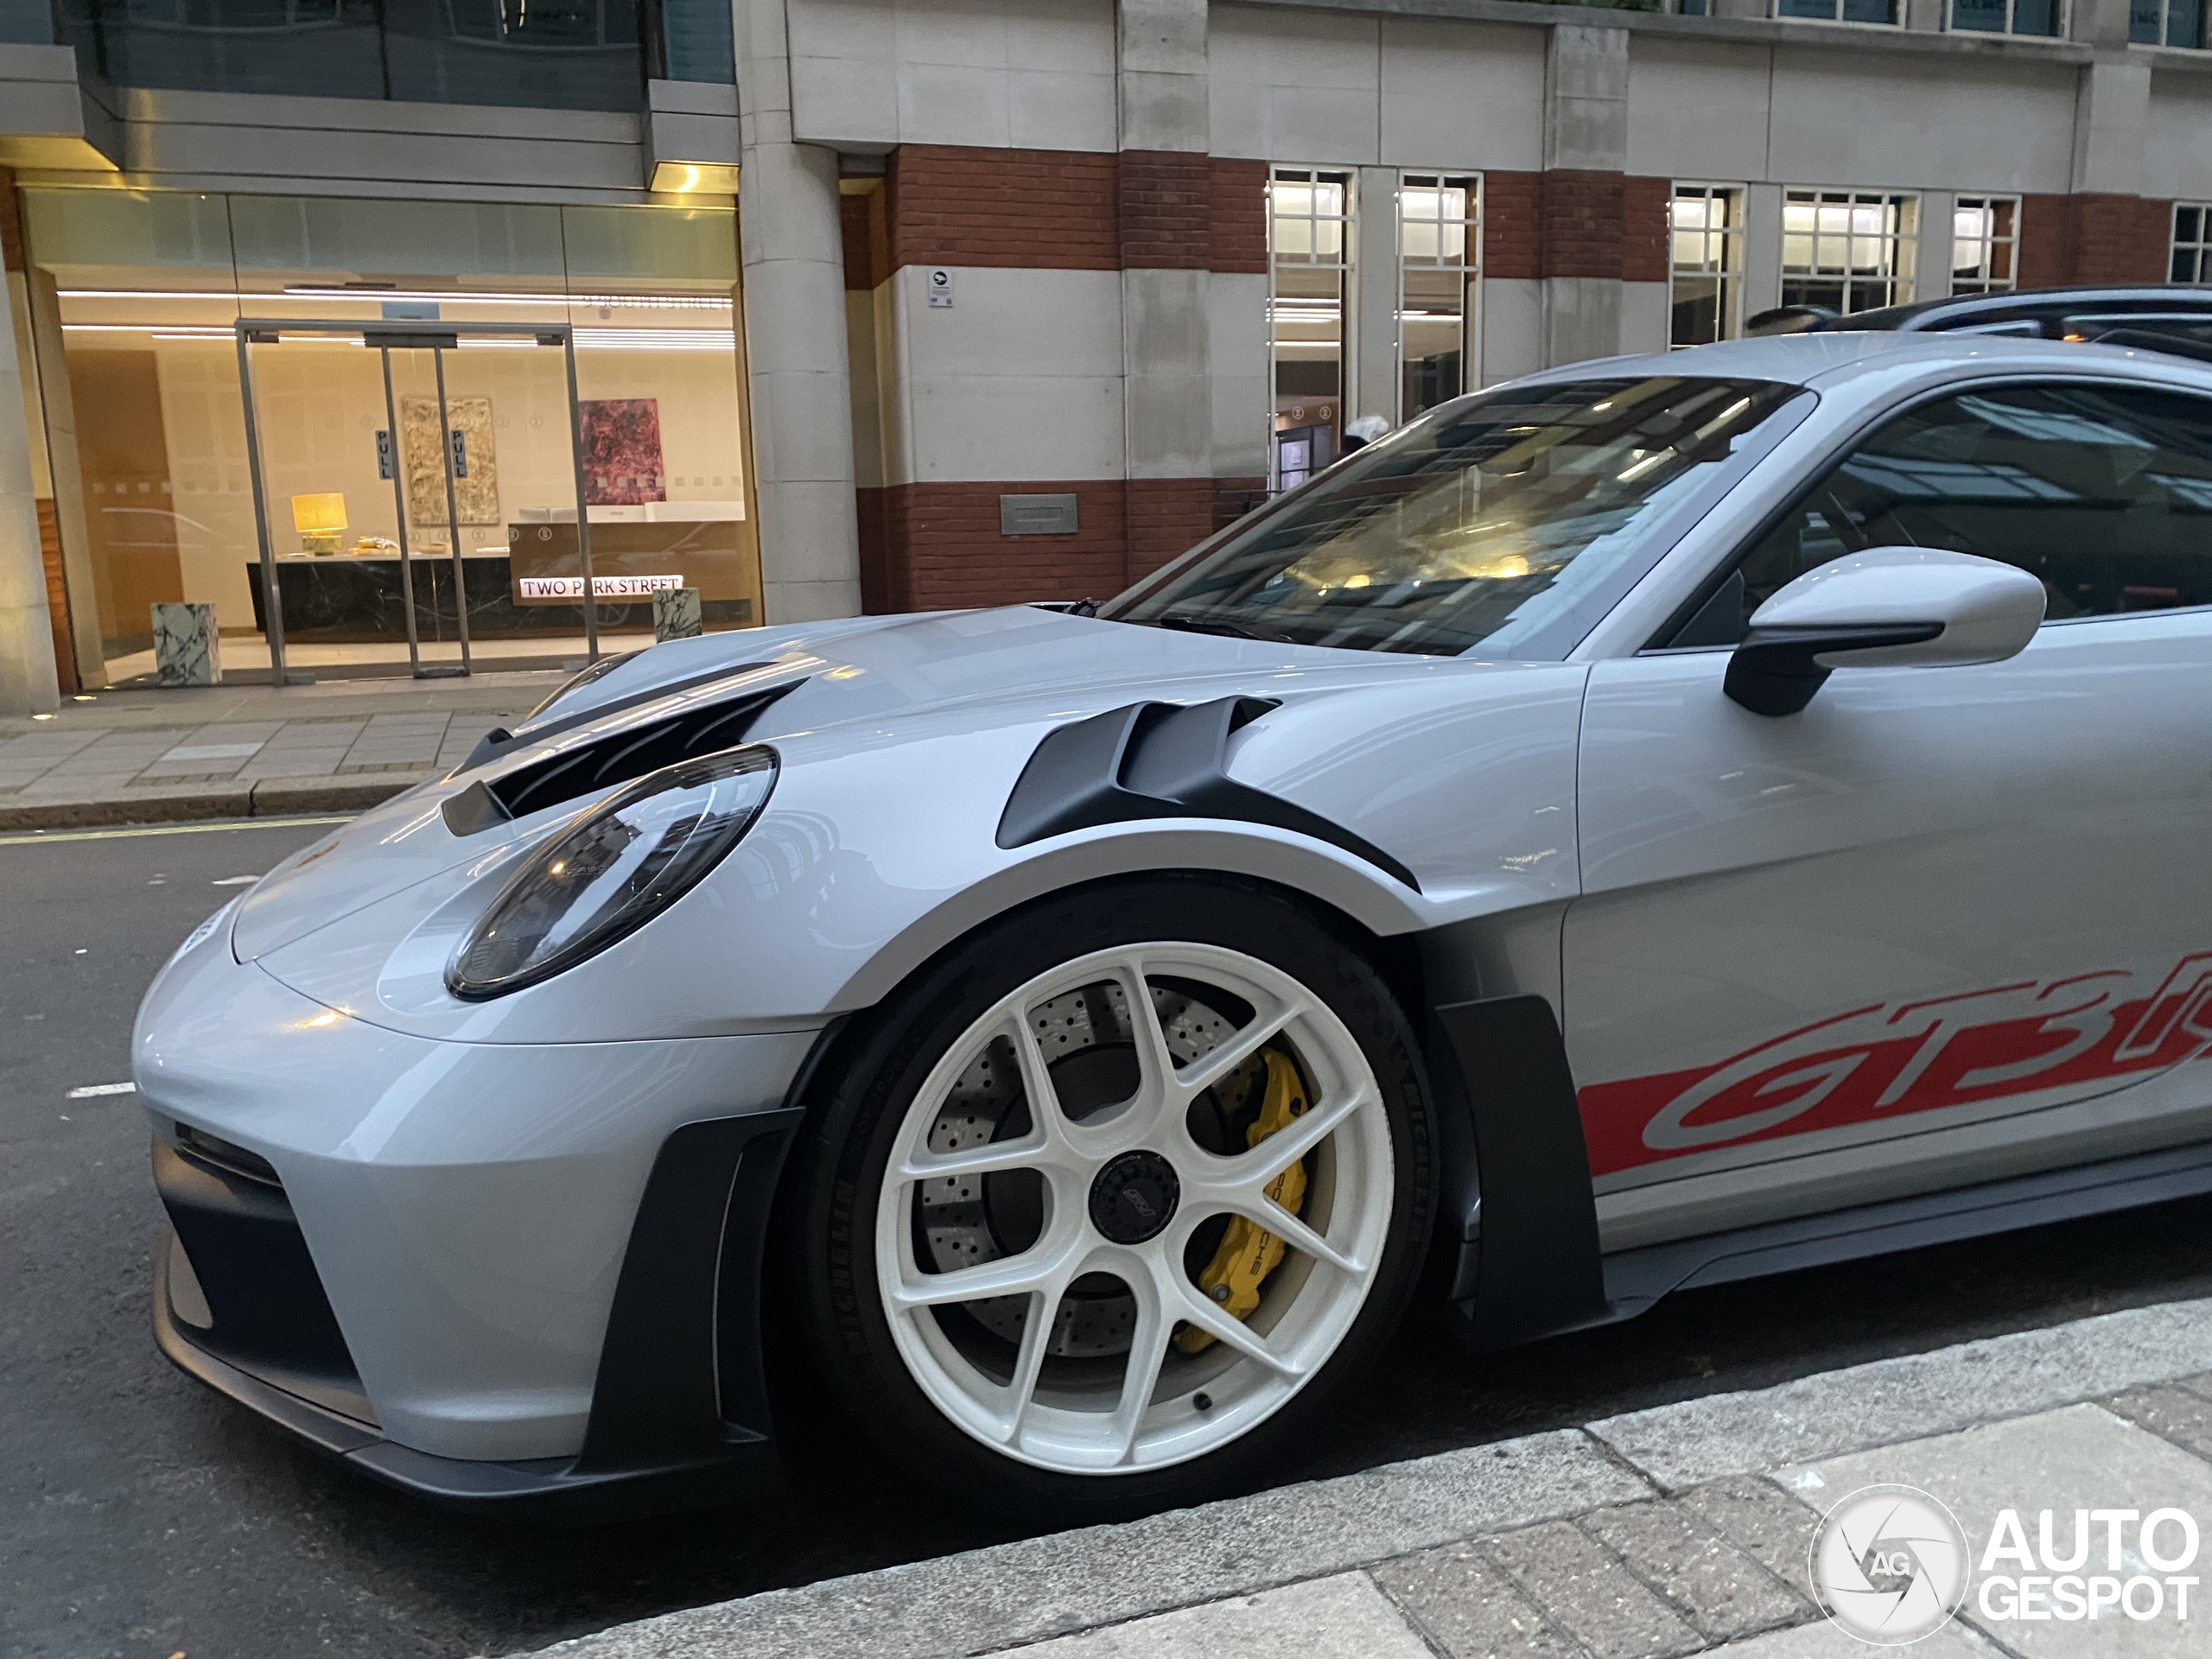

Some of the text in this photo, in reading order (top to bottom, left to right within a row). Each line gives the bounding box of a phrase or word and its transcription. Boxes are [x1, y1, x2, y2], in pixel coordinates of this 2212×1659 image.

[378, 431, 391, 479] PULL
[453, 430, 465, 478] PULL
[524, 581, 566, 595] TWO
[574, 580, 617, 594] PRK
[1249, 1172, 1286, 1276] POCHE
